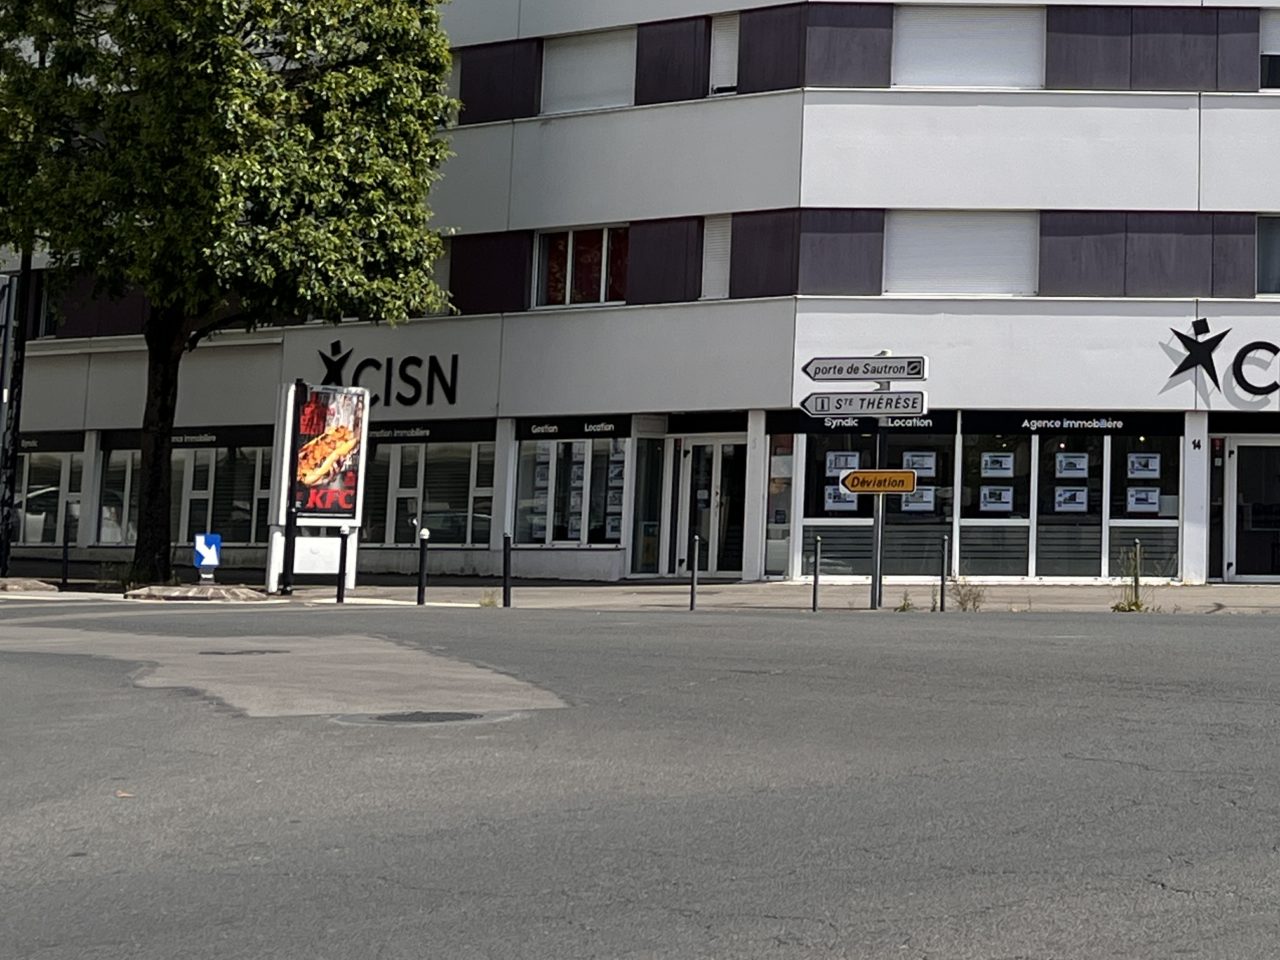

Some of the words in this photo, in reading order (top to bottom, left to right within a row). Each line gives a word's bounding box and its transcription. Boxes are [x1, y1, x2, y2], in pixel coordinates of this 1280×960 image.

[813, 365, 843, 378] porte
[846, 364, 860, 375] de
[862, 363, 906, 375] Sautron
[351, 353, 459, 407] CISN
[584, 422, 615, 433] Location
[824, 417, 859, 429] Syndic
[888, 417, 933, 427] Location
[1021, 419, 1061, 430] Agence
[1192, 439, 1201, 450] 14
[851, 476, 905, 488] Déviation
[305, 488, 354, 510] KFC
